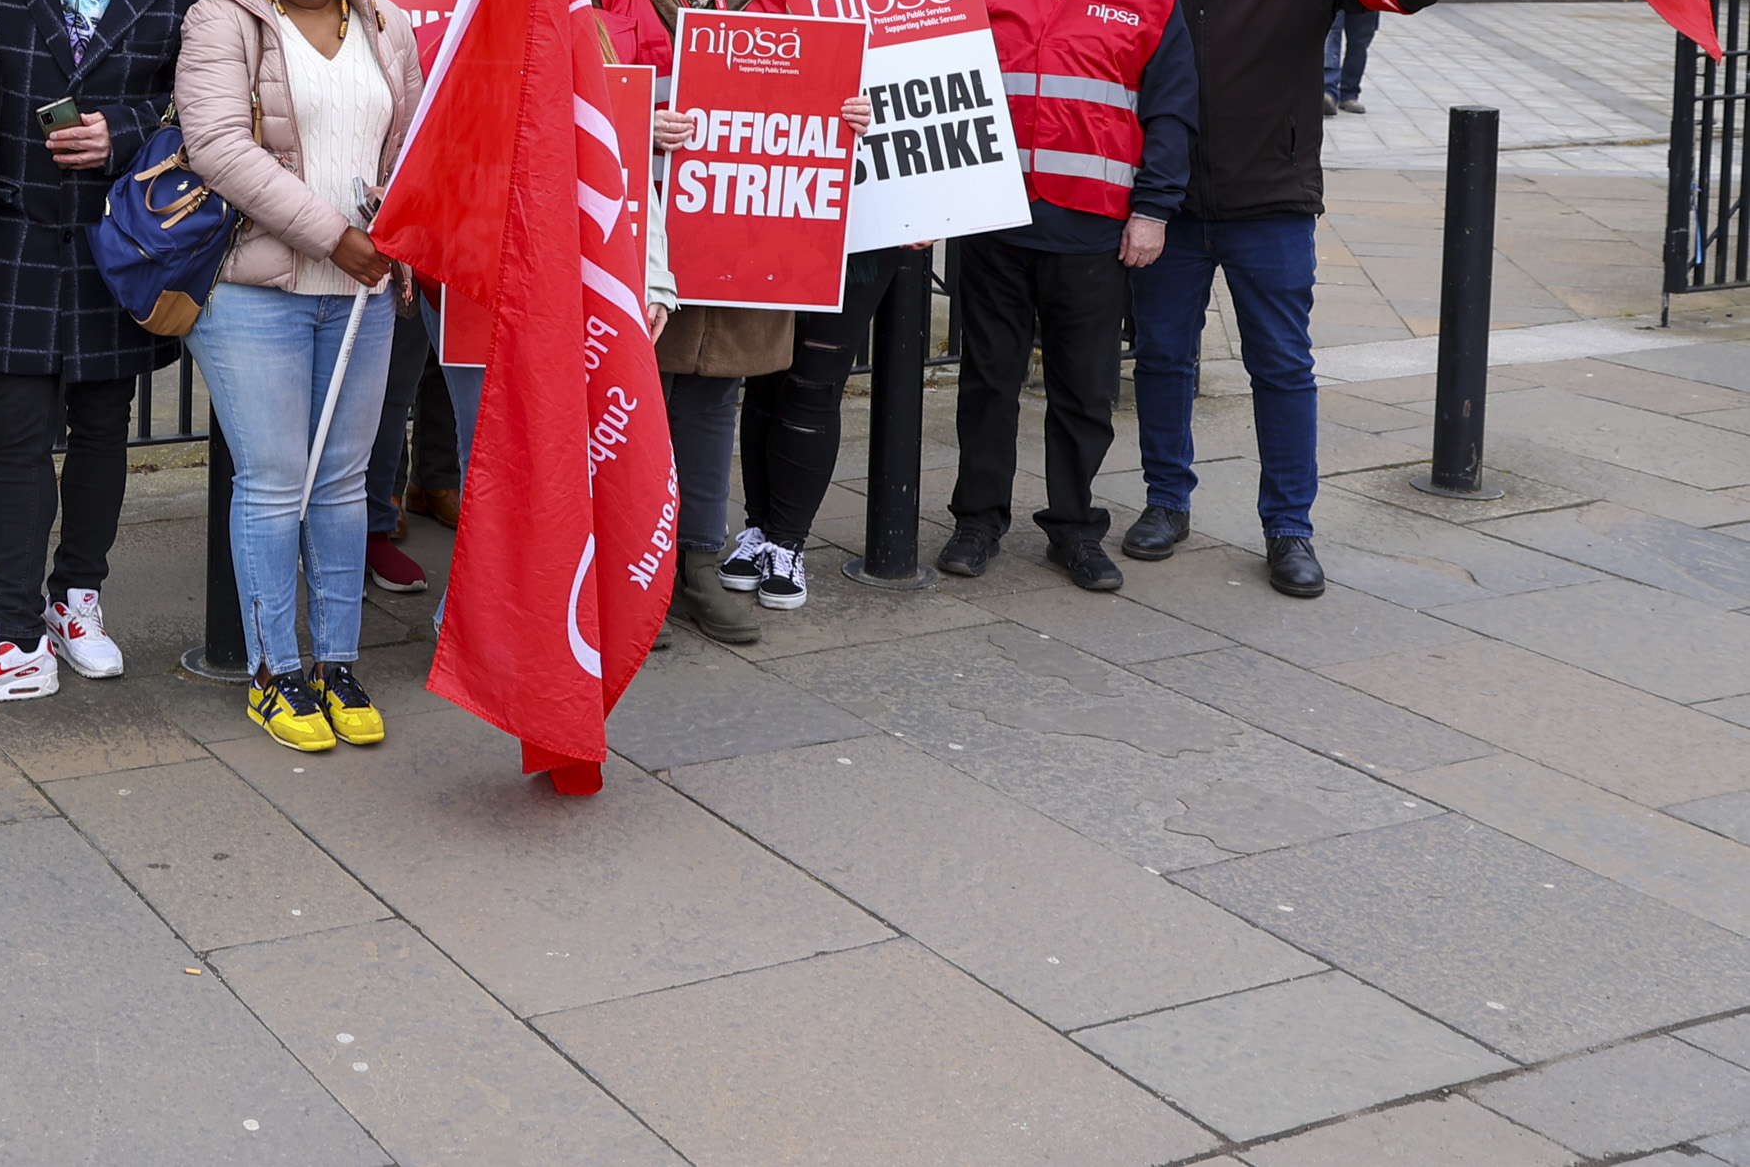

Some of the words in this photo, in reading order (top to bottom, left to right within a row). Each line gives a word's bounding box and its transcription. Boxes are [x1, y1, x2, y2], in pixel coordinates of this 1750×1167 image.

[874, 14, 906, 25] Protecting
[907, 9, 925, 20] Public
[926, 5, 951, 17] Services
[885, 21, 920, 34] Supporting
[920, 18, 939, 29] Public
[940, 14, 967, 24] Servants
[1086, 4, 1140, 26] nipsa
[689, 22, 801, 70] nipsa
[863, 69, 993, 125] FICIAL
[682, 107, 847, 159] OFFICIAL
[675, 159, 844, 220] STRIKE
